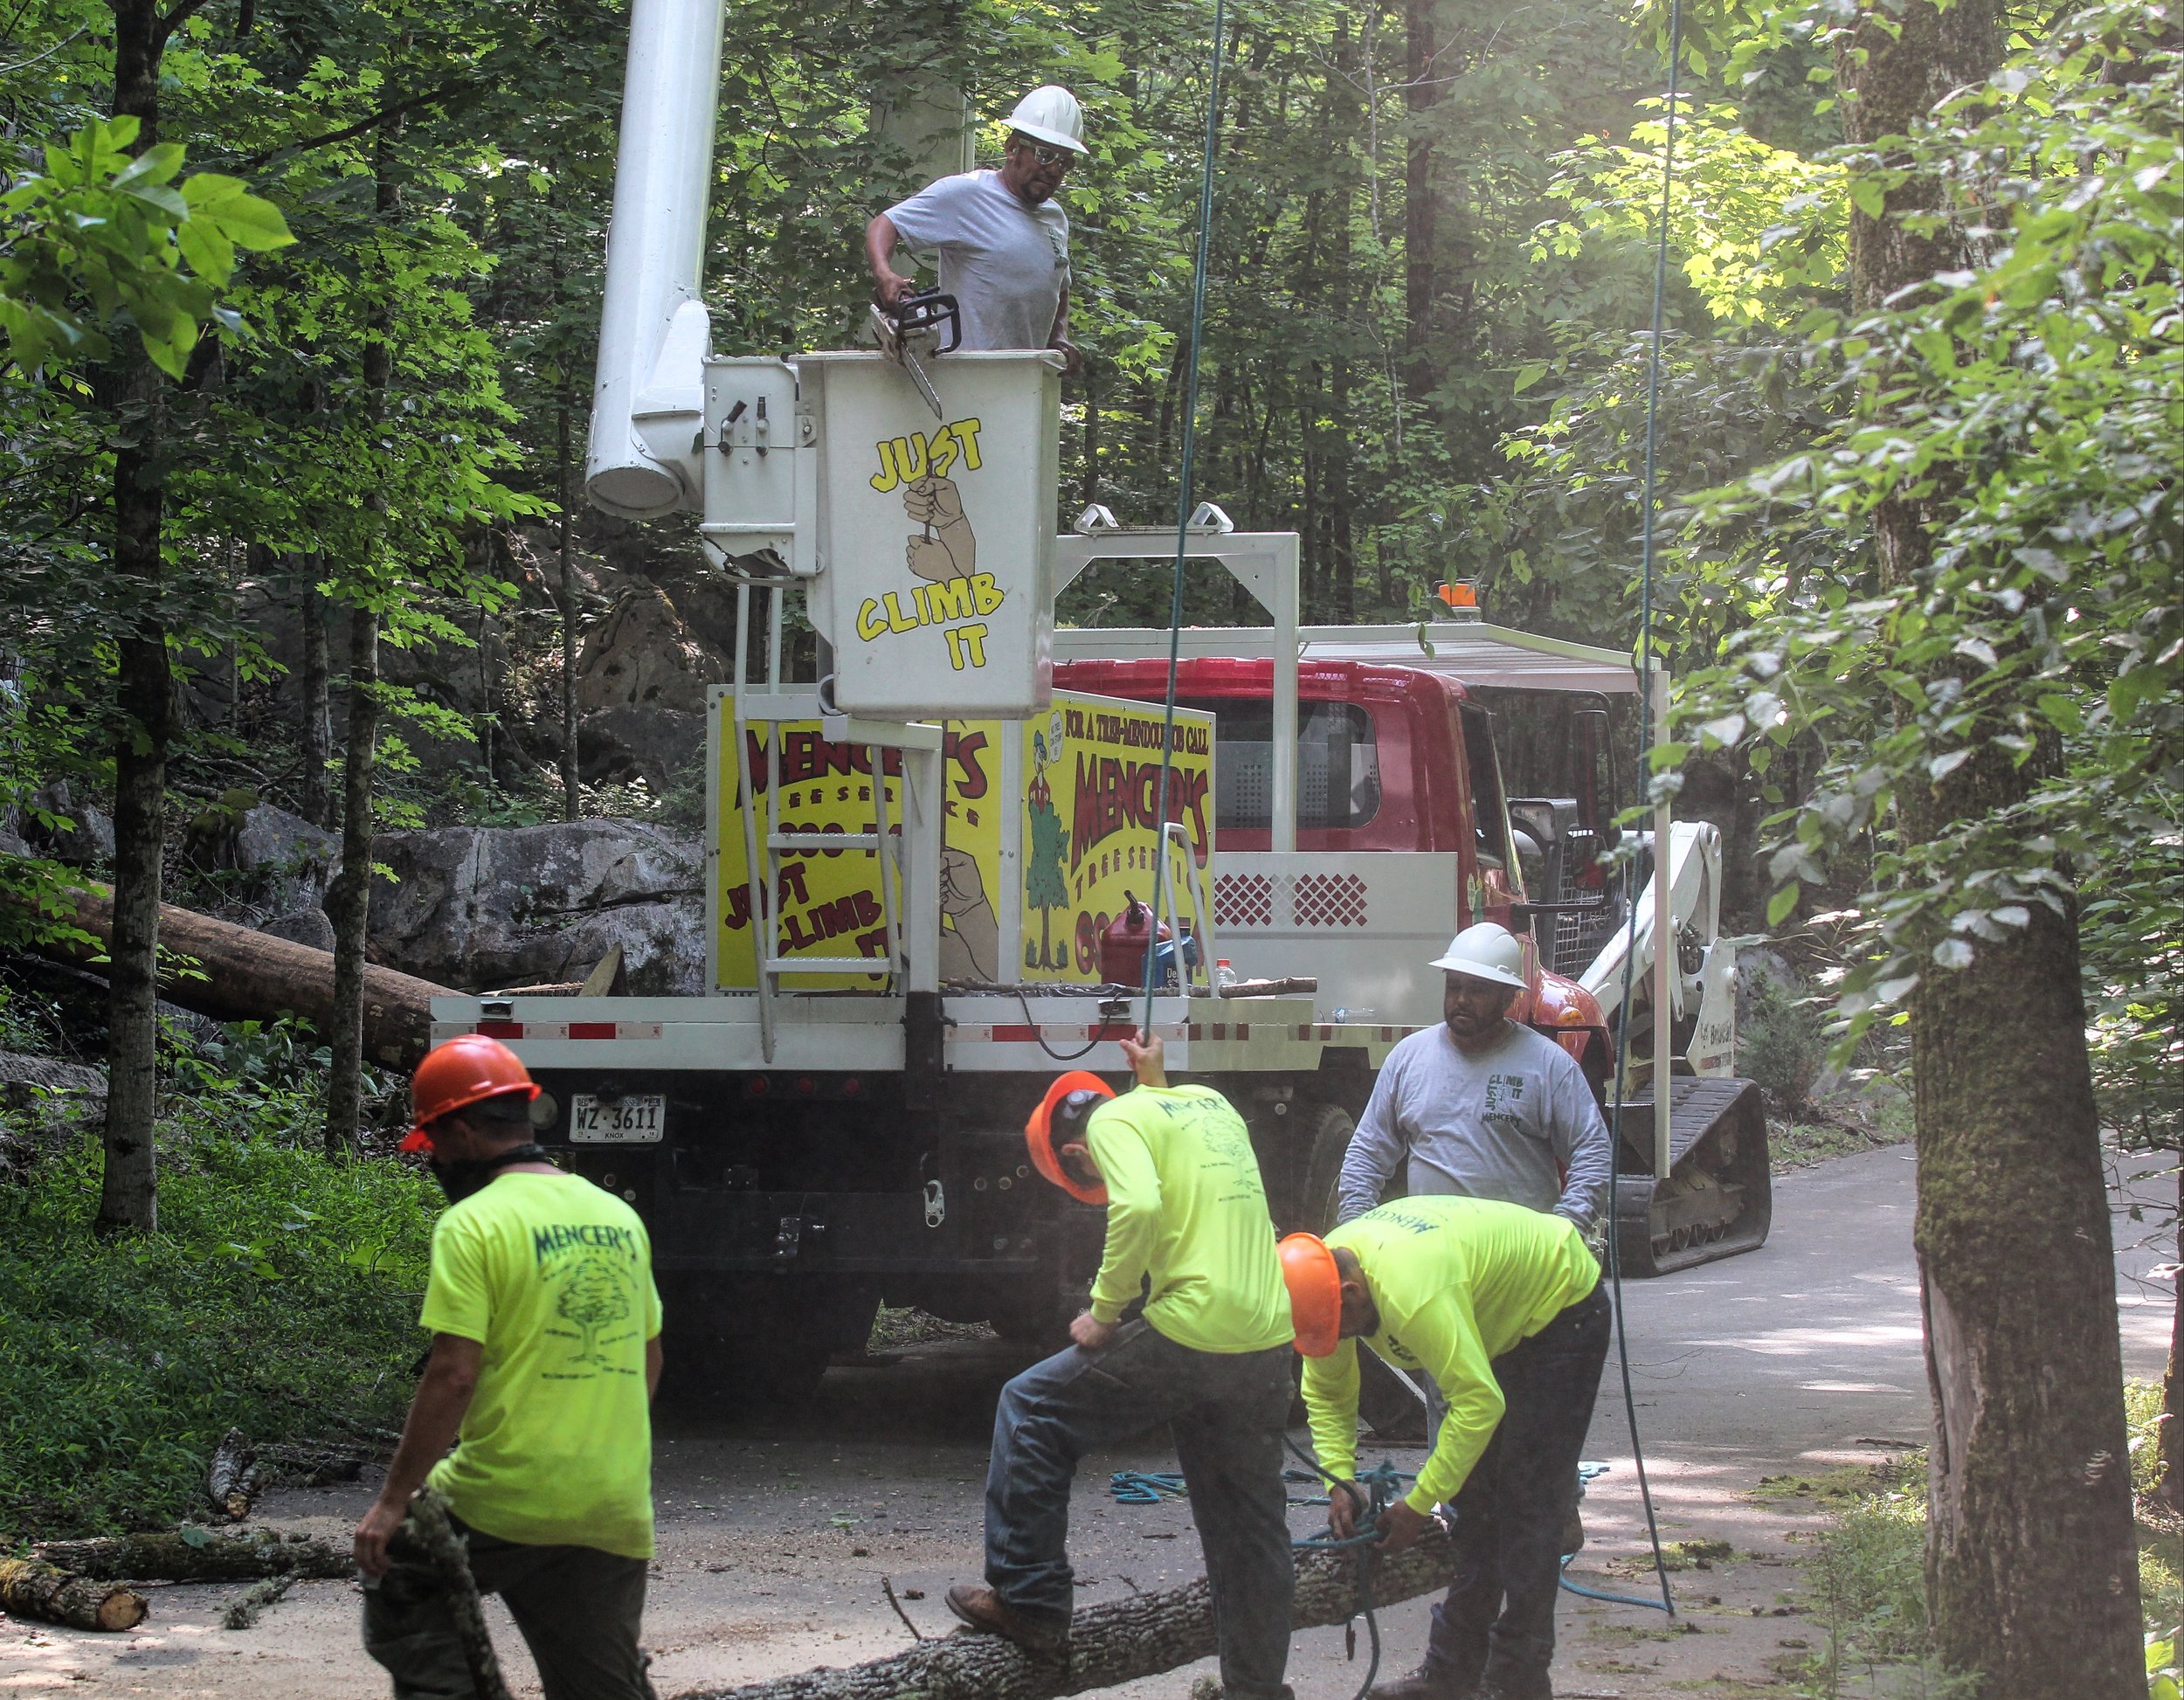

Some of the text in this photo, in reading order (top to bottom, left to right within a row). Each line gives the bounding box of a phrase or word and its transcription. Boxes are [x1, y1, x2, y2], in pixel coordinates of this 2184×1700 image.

[870, 418, 982, 493] JUST
[856, 572, 1004, 641] CLIMB
[944, 624, 988, 670] IT
[1065, 709, 1084, 739] FOR
[1086, 713, 1095, 741] A
[1096, 714, 1169, 750] TREE-MENDOU
[1170, 724, 1184, 756] OB
[1186, 727, 1209, 756] CALL
[735, 729, 989, 810] MENCE'S
[1075, 847, 1121, 902] TREE
[1511, 1088, 1523, 1100] IT
